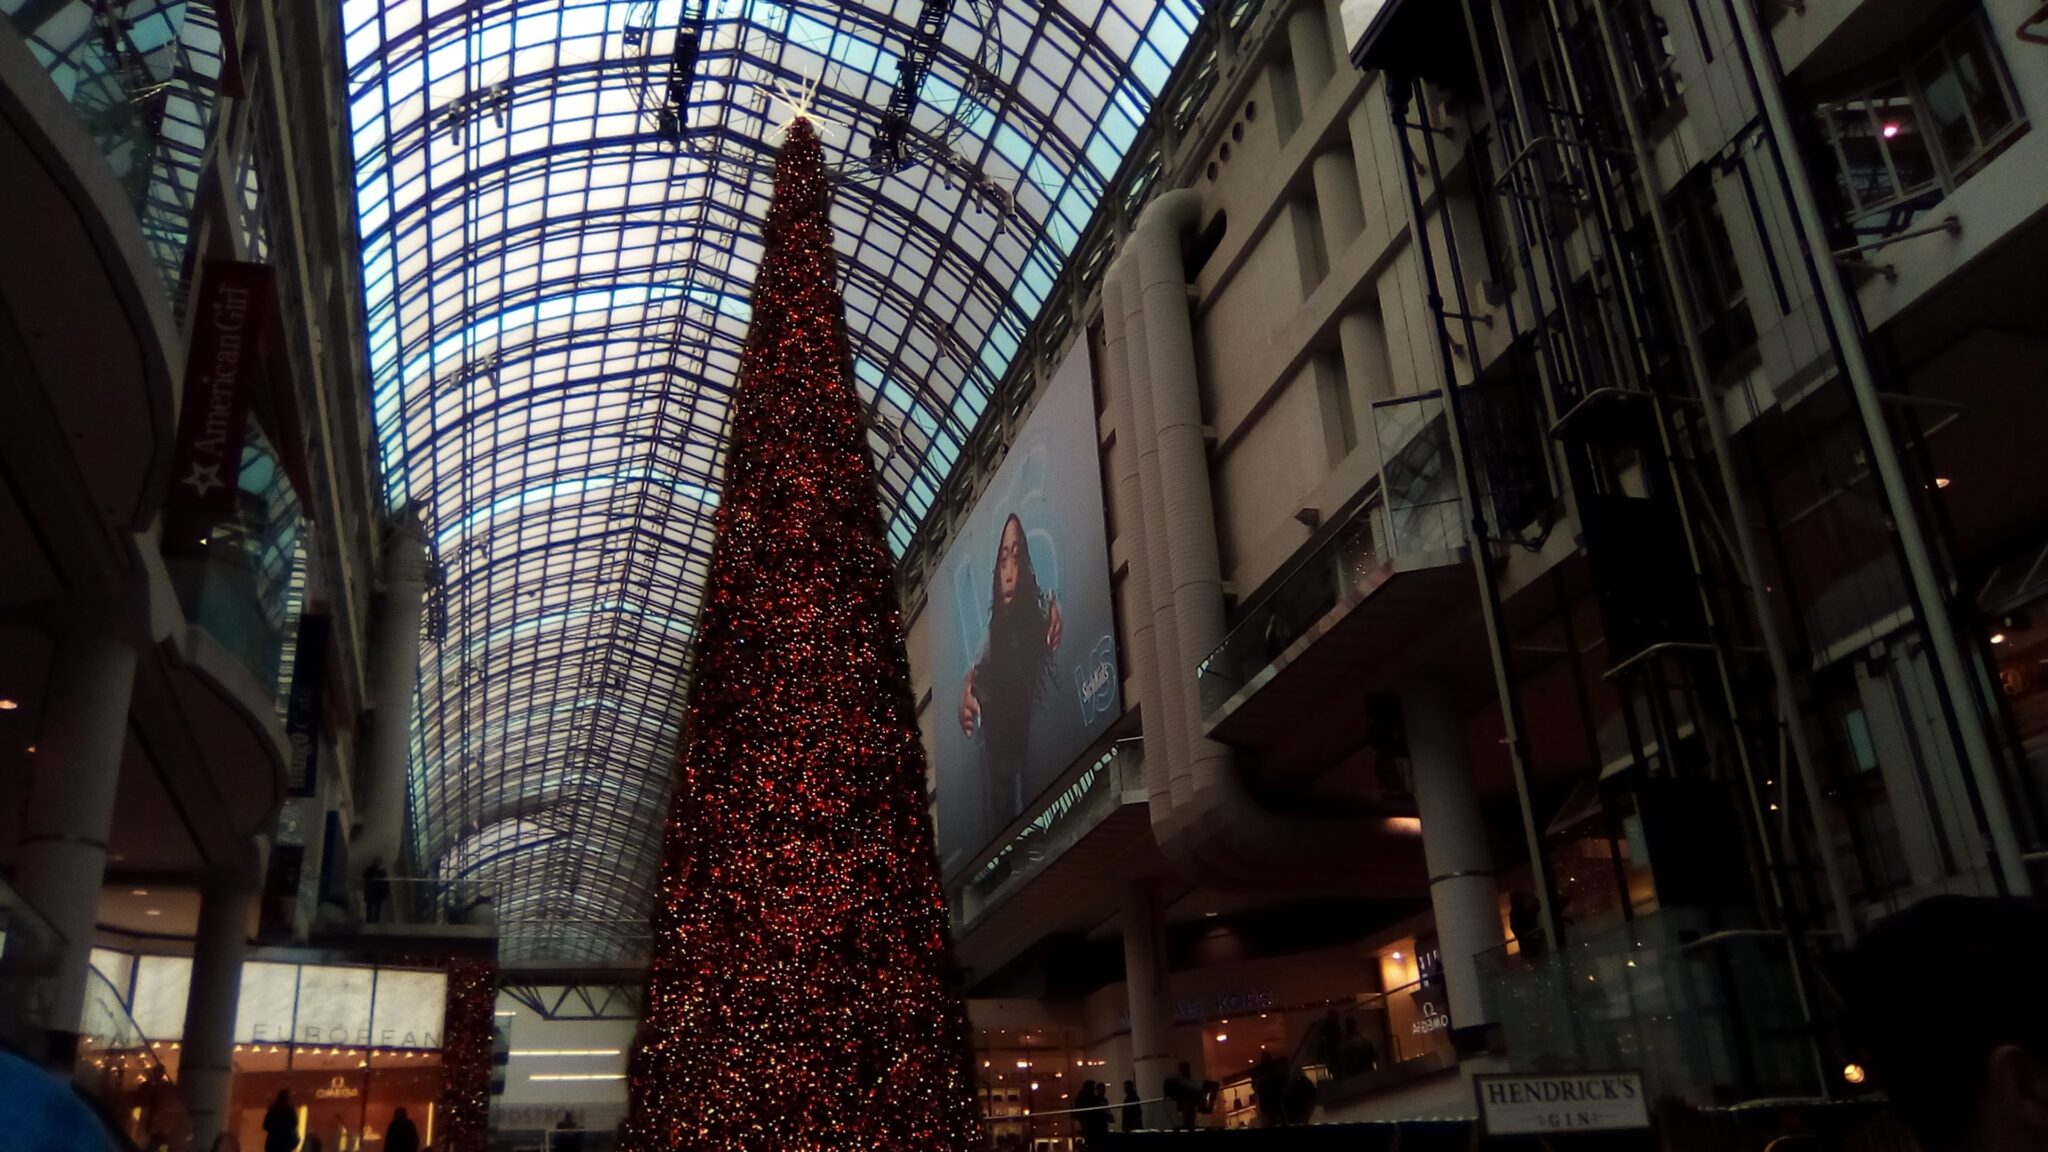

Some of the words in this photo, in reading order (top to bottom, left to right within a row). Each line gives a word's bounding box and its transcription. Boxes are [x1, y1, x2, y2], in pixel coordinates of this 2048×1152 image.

[212, 281, 249, 331] Girl
[192, 335, 241, 458] American
[1488, 1076, 1635, 1105] HENDRICK'S
[1548, 1112, 1590, 1128] GIN
